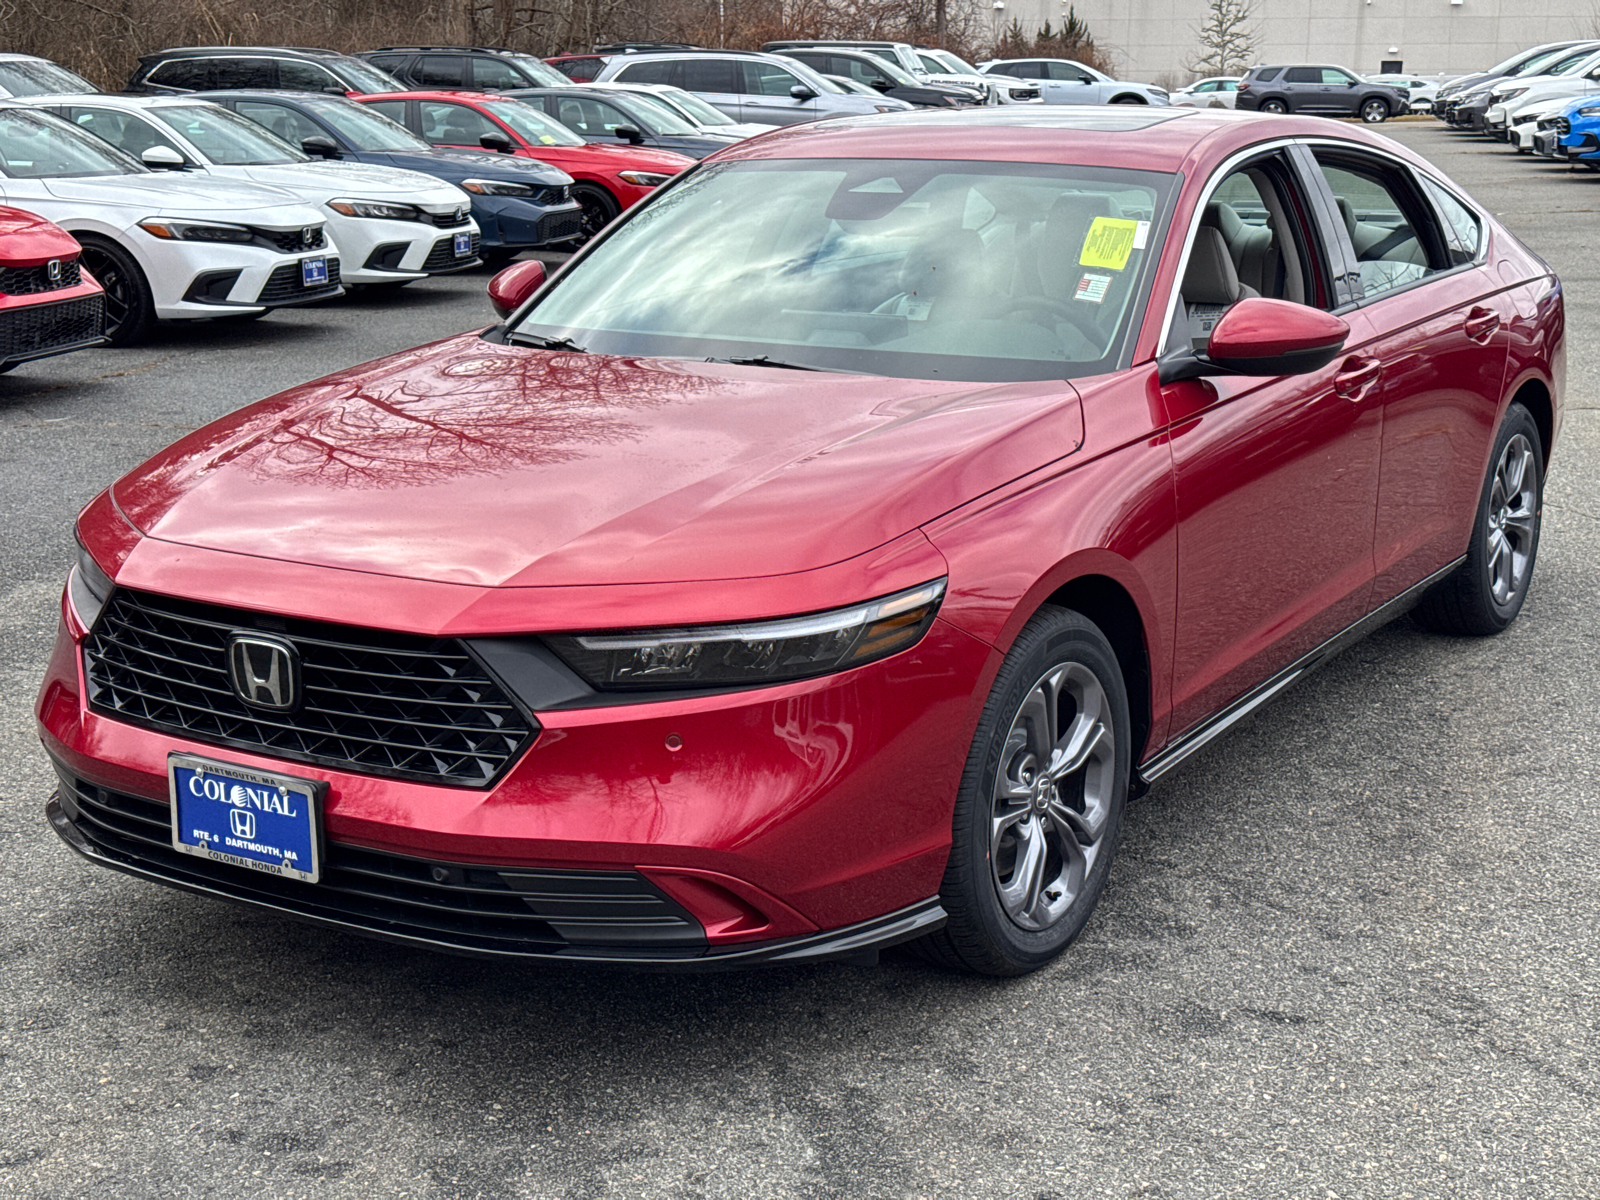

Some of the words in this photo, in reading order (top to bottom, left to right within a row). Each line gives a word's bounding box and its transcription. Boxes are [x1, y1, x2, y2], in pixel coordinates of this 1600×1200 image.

[262, 777, 277, 786] MA
[188, 775, 297, 818] COLONIAL
[193, 829, 212, 842] RTE.
[213, 834, 219, 843] 6
[225, 836, 283, 859] DARTMOUTH,
[284, 850, 298, 861] MA
[207, 850, 250, 868] COLONIAL
[251, 859, 283, 875] HONDA
